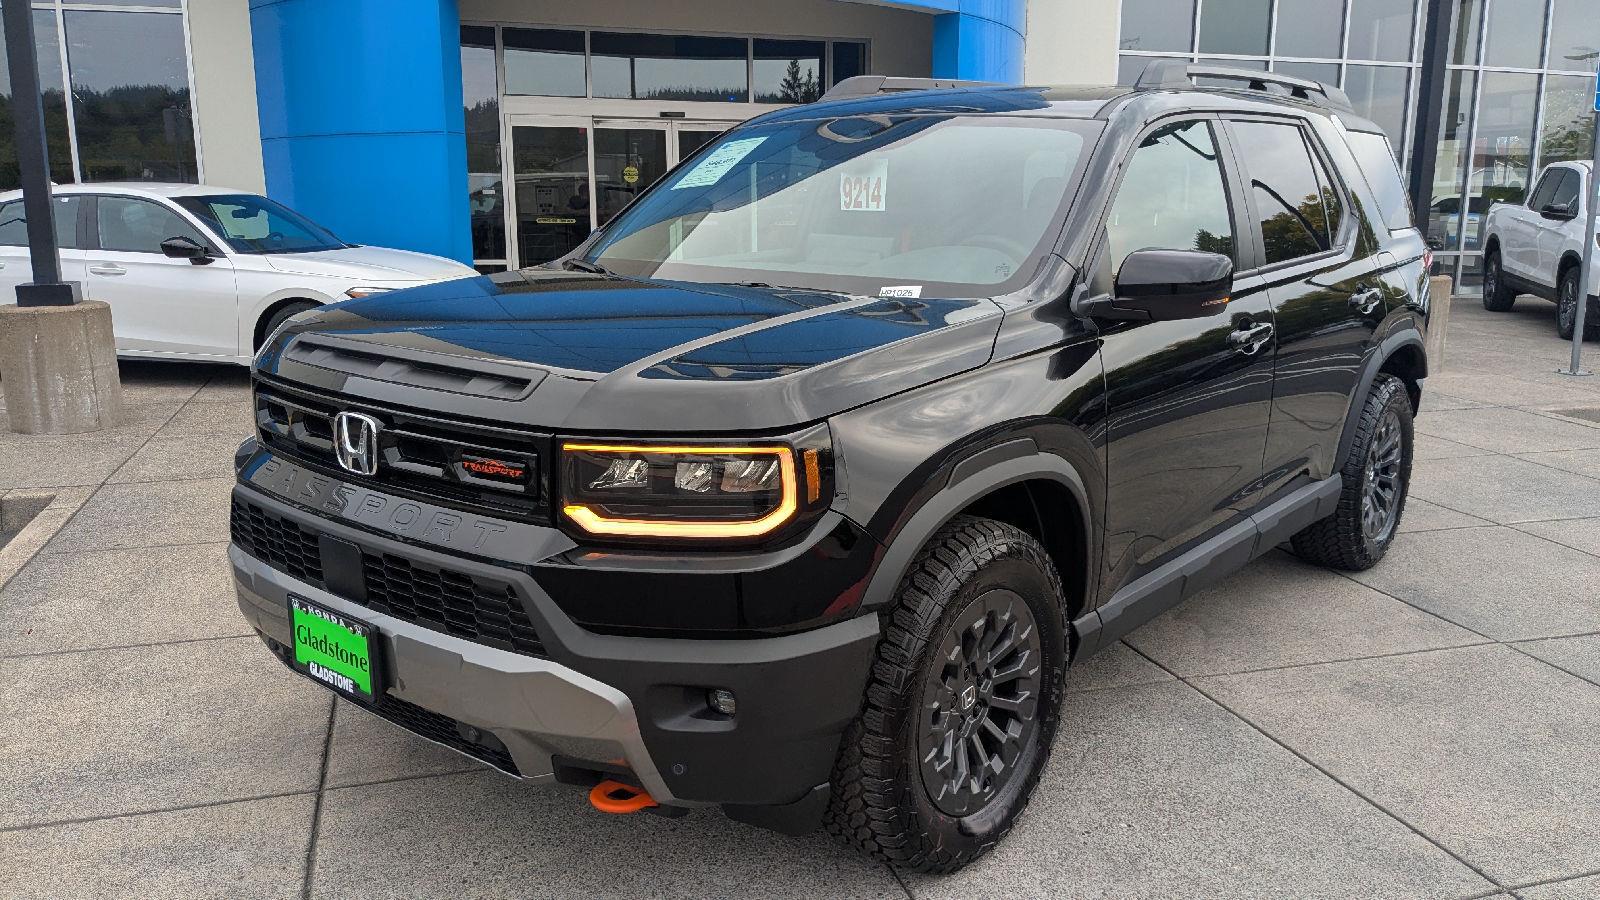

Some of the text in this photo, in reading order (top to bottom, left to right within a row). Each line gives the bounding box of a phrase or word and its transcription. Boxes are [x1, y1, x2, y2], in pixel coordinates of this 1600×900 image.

[842, 175, 882, 209] 9214
[253, 459, 508, 549] PASSPORT
[307, 605, 346, 628] HONDA
[296, 624, 368, 672] Gladstone
[309, 661, 354, 693] GLADSTONE
